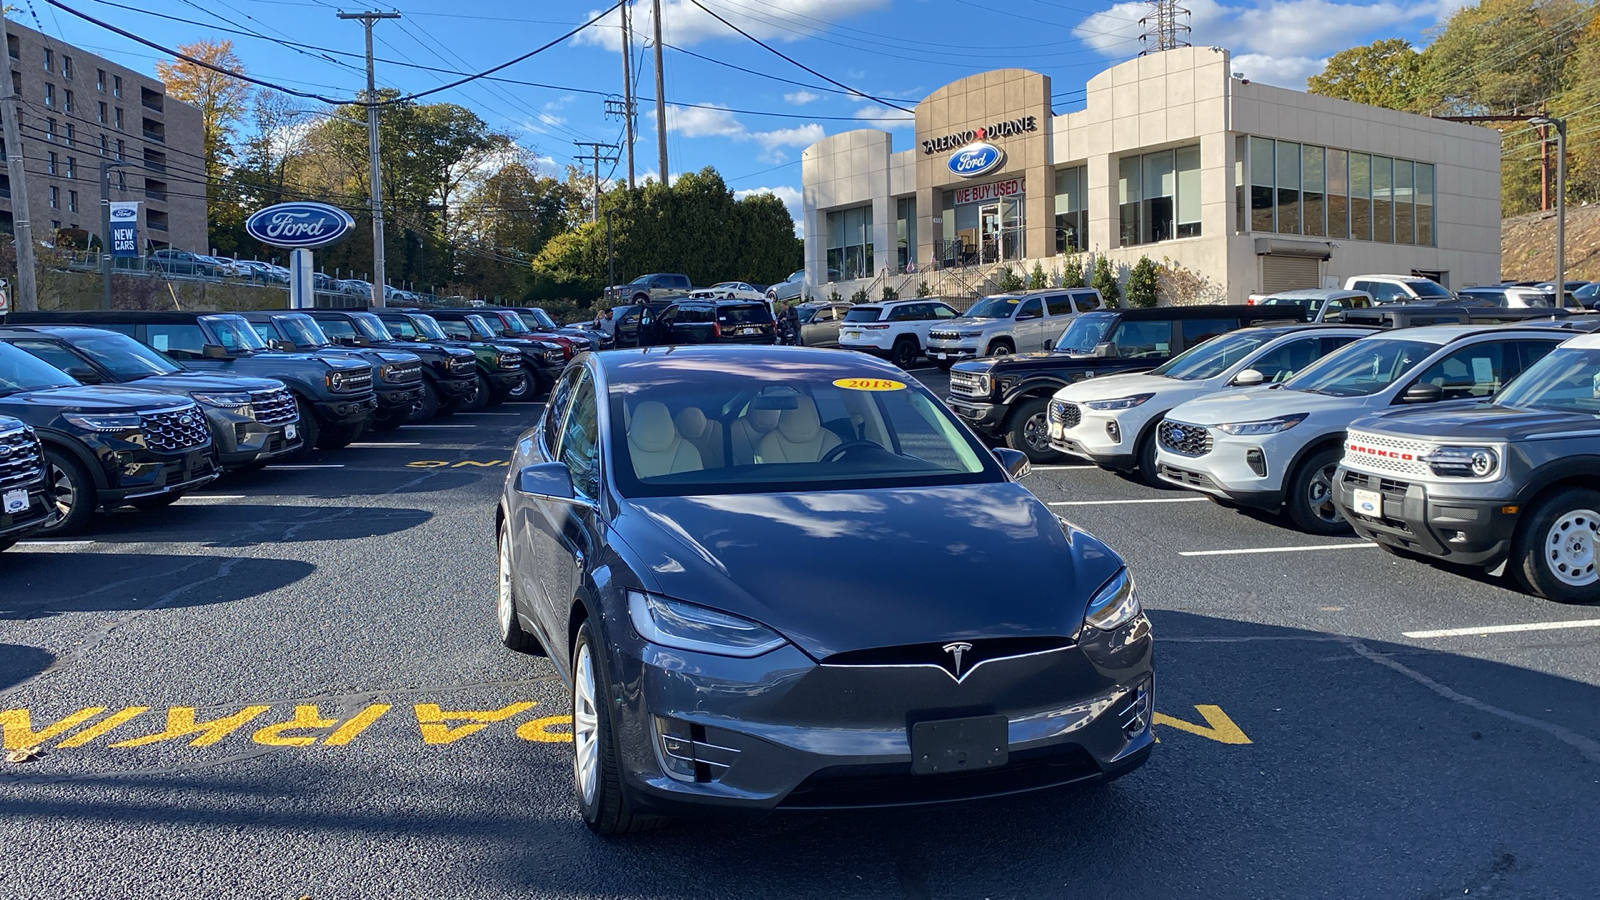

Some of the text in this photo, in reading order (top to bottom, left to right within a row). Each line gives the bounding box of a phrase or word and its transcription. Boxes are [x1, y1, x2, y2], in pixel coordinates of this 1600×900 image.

[922, 116, 1037, 153] SALERNO DUANE
[957, 150, 987, 171] Ford
[956, 189, 970, 204] WE
[972, 184, 991, 200] BUY
[993, 180, 1018, 197] USED
[267, 212, 326, 237] Ford
[114, 229, 134, 240] NEW
[115, 241, 135, 250] CARS
[848, 380, 893, 389] 2018
[1350, 444, 1413, 461] BRONCO
